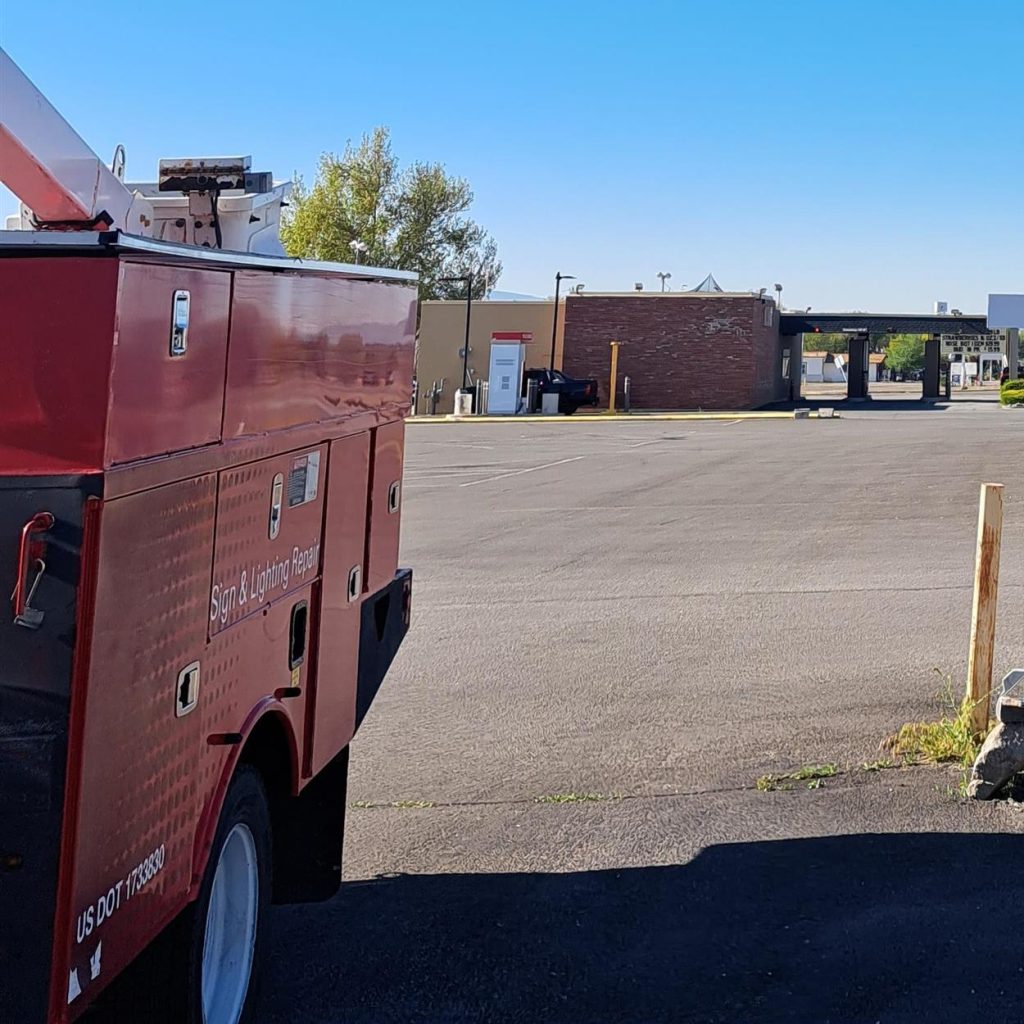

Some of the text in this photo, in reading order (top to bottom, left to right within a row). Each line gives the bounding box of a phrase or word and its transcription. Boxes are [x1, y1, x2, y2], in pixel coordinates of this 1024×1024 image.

[210, 537, 320, 624] Sign & Lighting Repair
[76, 843, 165, 944] US DOT 1733830
